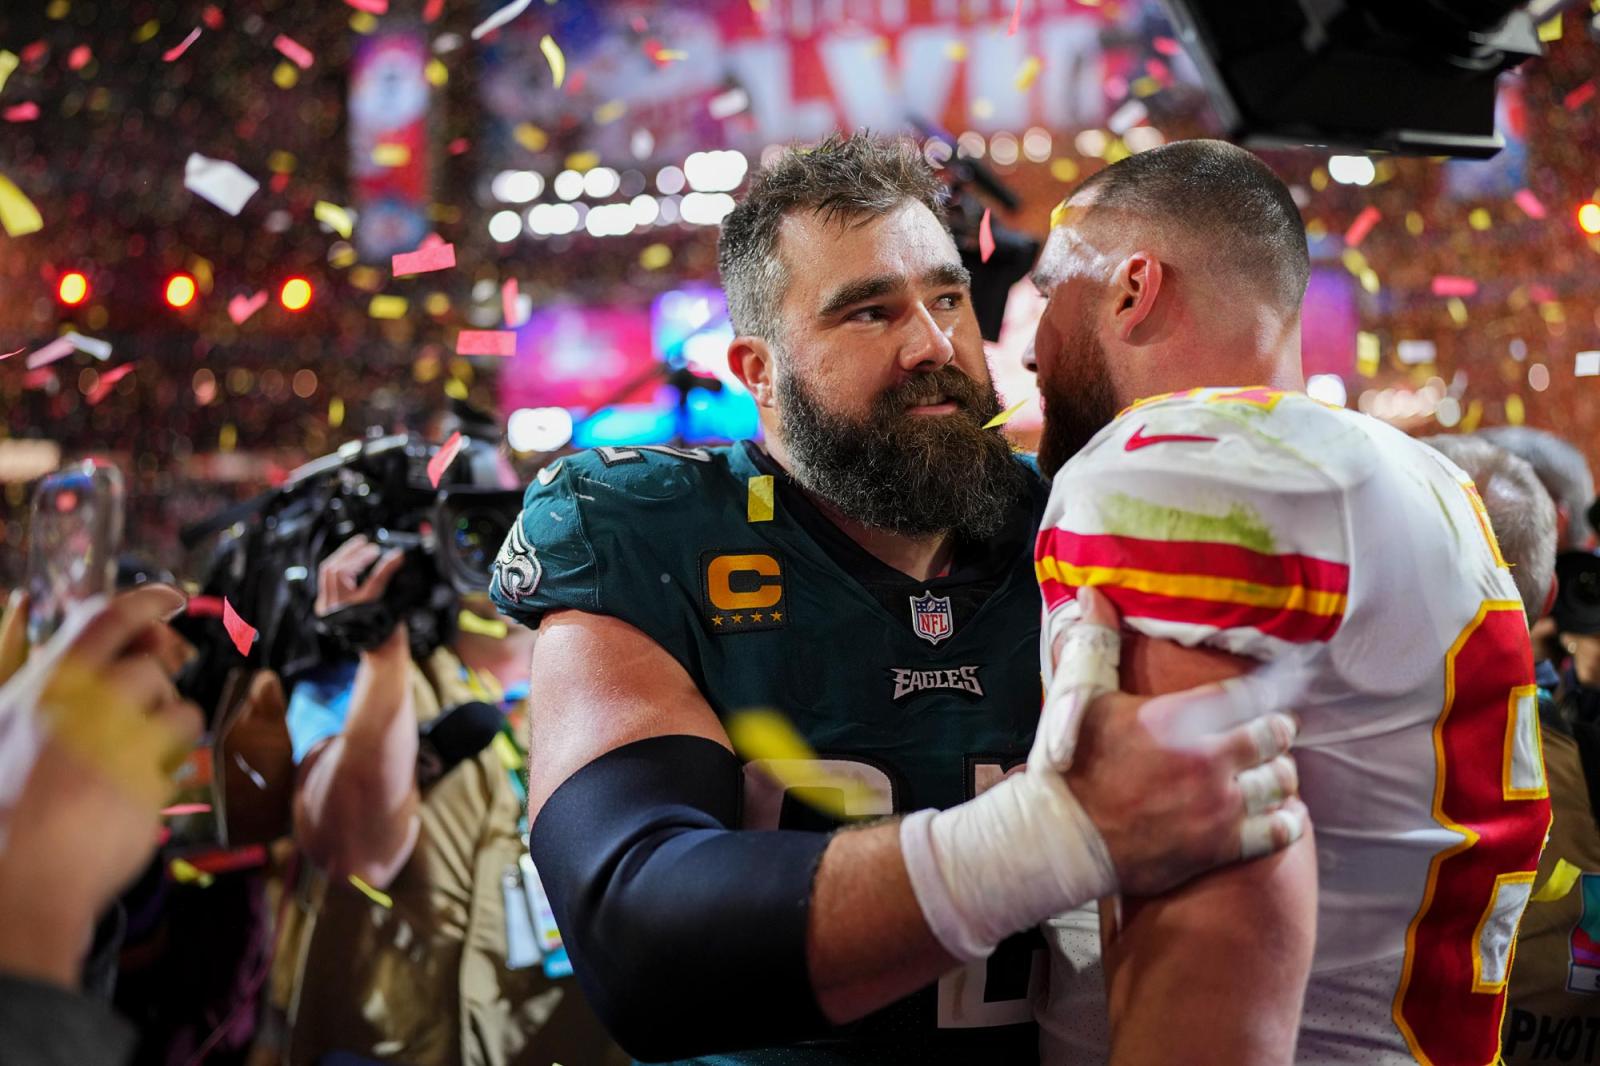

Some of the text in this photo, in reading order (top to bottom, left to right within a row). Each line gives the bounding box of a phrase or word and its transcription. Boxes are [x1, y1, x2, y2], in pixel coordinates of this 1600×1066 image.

[707, 554, 782, 610] C
[920, 613, 948, 635] NFL
[890, 665, 984, 700] EAGLES
